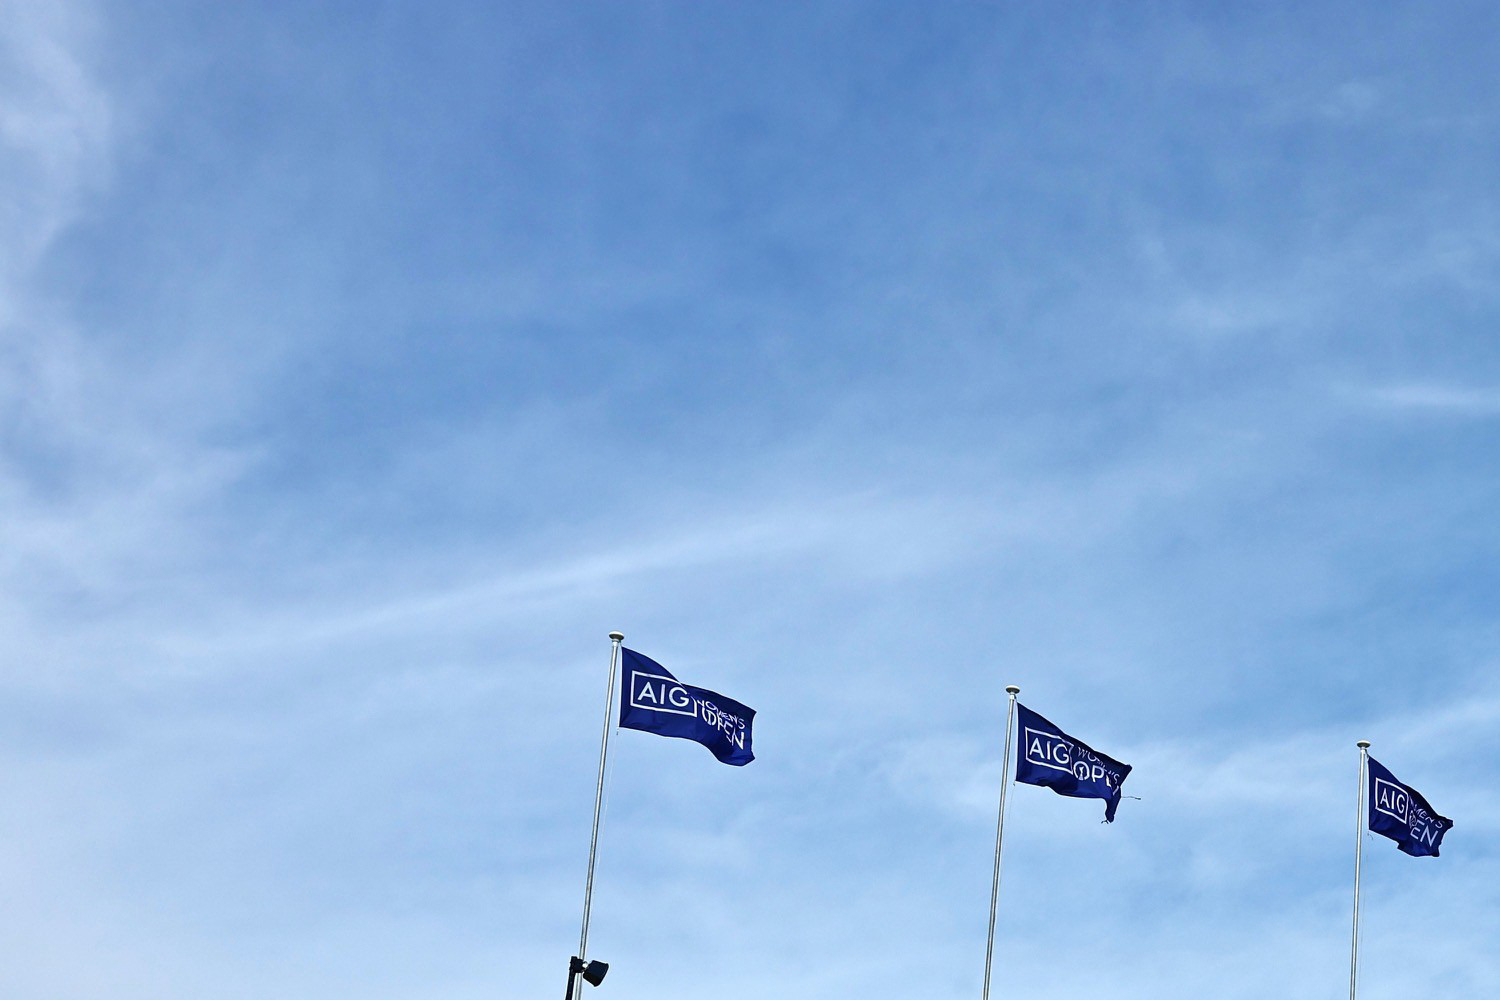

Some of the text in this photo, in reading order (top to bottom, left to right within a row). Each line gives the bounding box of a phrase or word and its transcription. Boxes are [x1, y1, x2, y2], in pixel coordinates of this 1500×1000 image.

[637, 681, 690, 707] AIG
[1029, 737, 1070, 765] AIG
[1380, 787, 1406, 814] AIG
